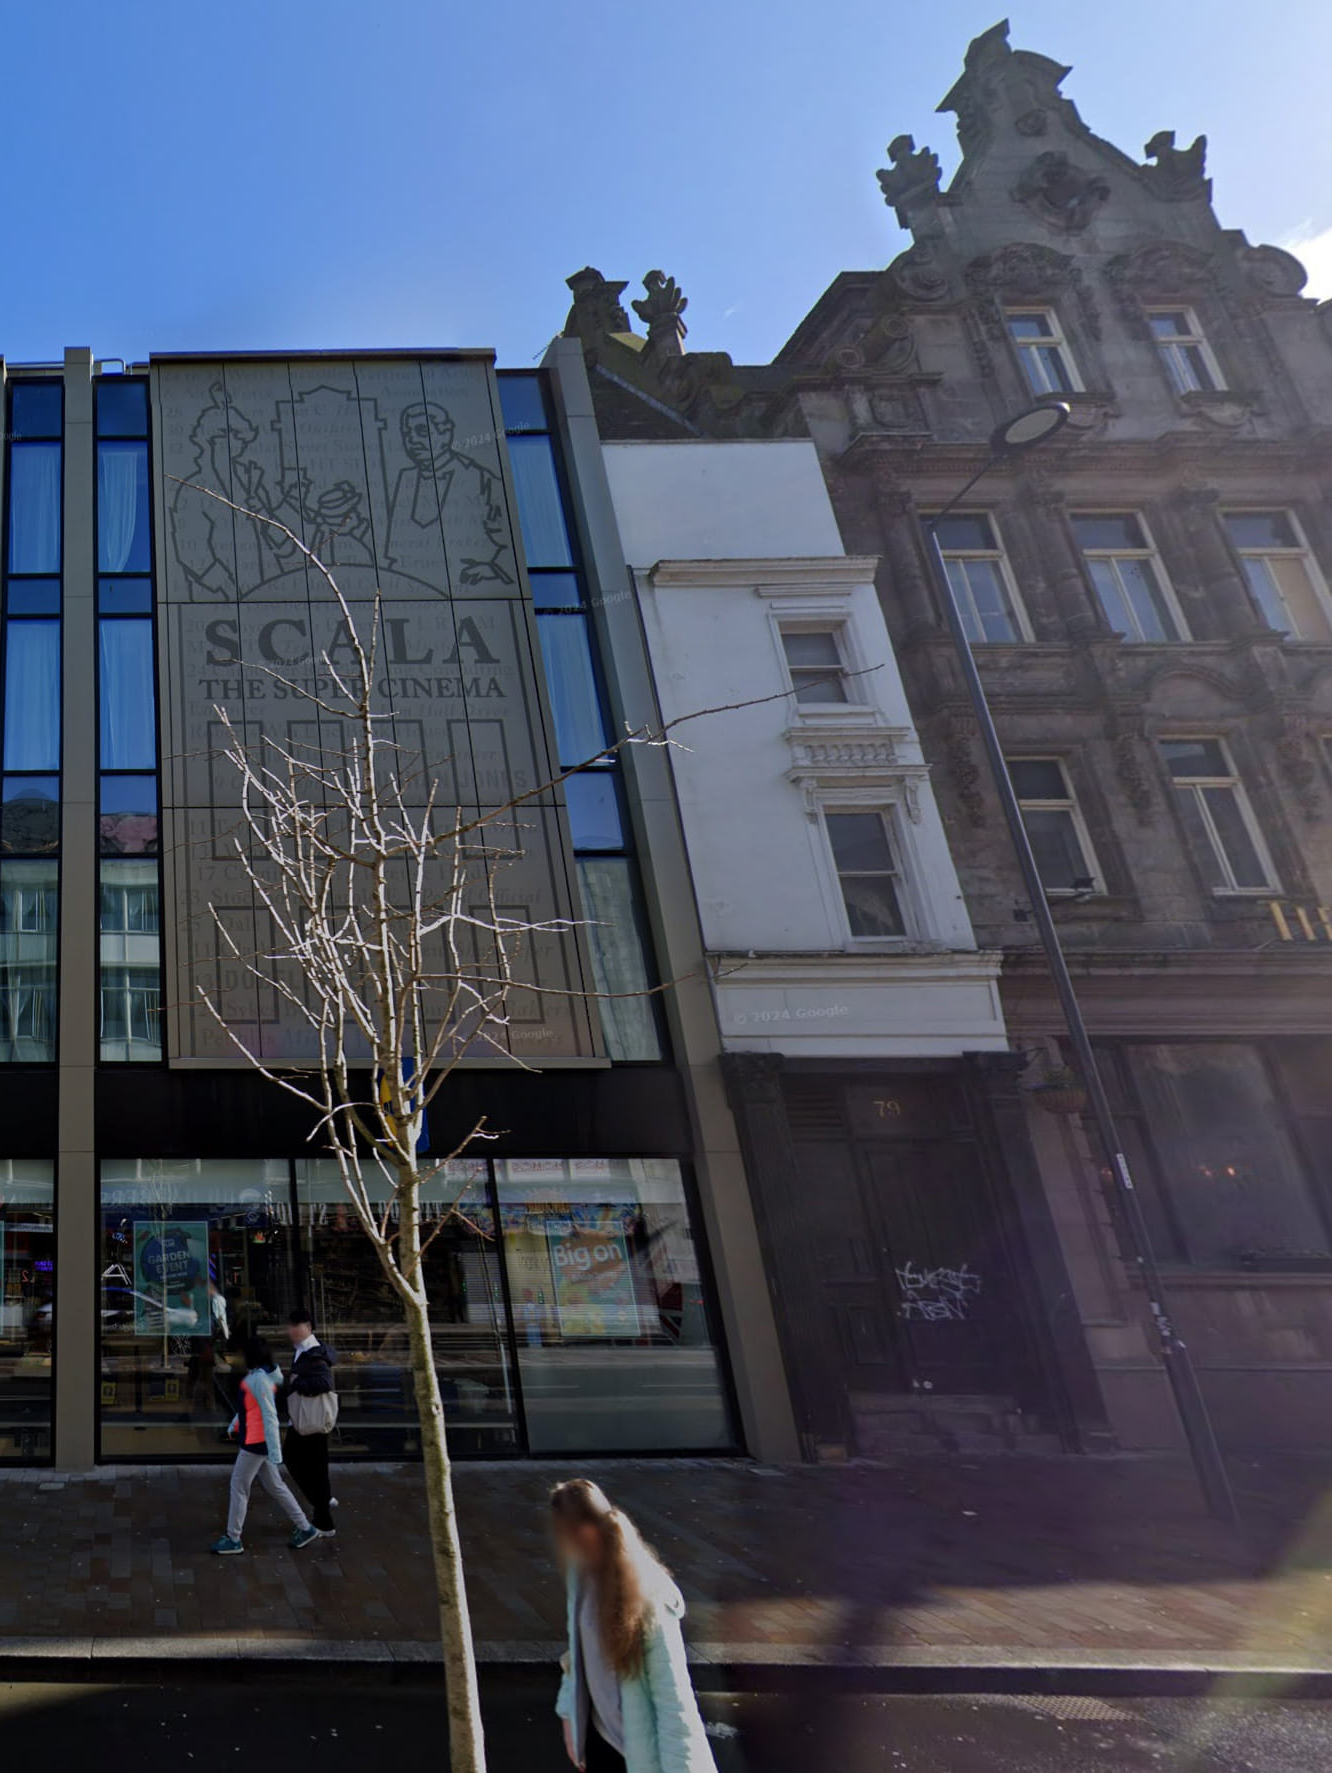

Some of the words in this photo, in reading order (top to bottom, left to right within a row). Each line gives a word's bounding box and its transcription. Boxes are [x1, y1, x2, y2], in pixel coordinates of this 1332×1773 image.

[205, 616, 502, 667] SCALA
[198, 678, 267, 701] THE
[376, 676, 509, 699] CINEMA
[147, 1249, 190, 1265] GARDEN
[155, 1259, 189, 1274] EVENT
[553, 1242, 591, 1271] Big
[592, 1242, 623, 1262] on
